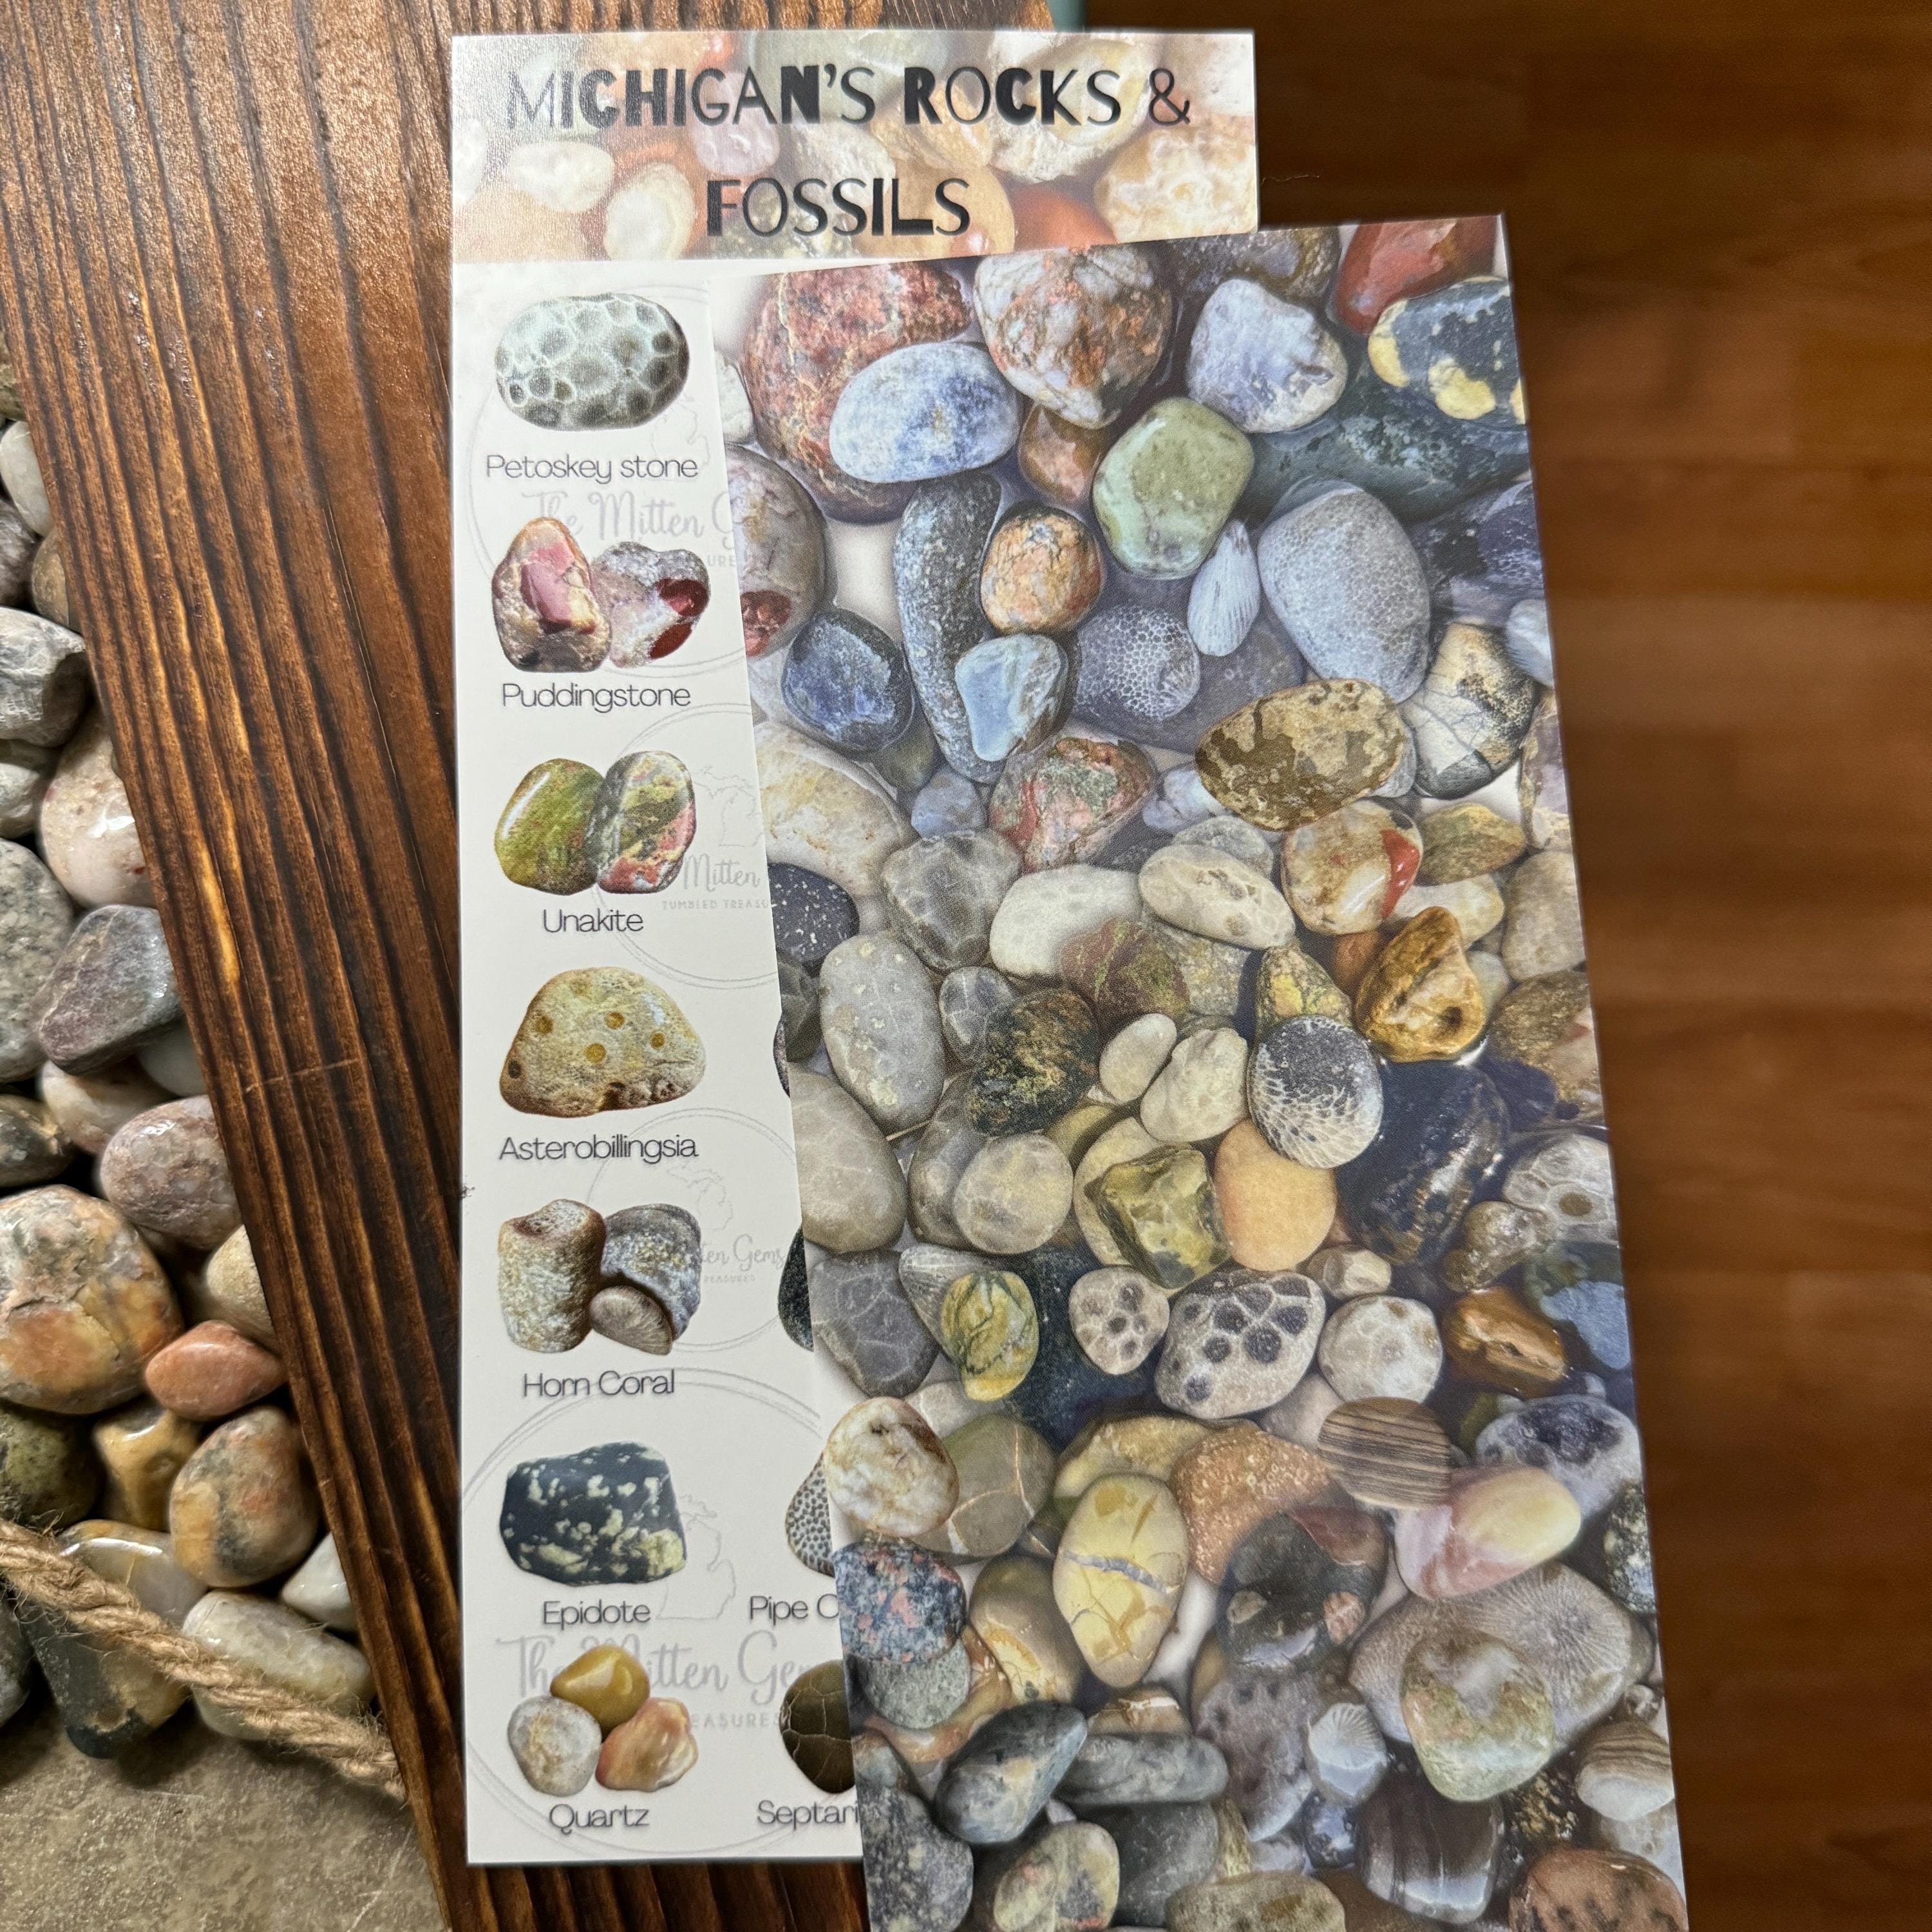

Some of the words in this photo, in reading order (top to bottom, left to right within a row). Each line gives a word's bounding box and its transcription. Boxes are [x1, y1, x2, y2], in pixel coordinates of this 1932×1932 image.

[506, 66, 875, 129] MICHIGAN'S
[904, 66, 1121, 126] ROCKS
[1149, 66, 1191, 125] &
[706, 176, 970, 238] FOSSILS
[486, 453, 611, 485] Petoskey
[620, 455, 699, 478] stone
[587, 490, 705, 541] Mitten
[502, 683, 691, 713] Puddingstone
[724, 899, 770, 909] TREASU
[542, 908, 644, 933] Unakite
[499, 1134, 699, 1164] Asterobillingsia
[524, 1372, 591, 1397] Horn
[599, 1369, 675, 1396] Coral
[543, 1600, 651, 1631] Epidote
[750, 1595, 809, 1627] Pipe
[817, 1593, 839, 1619] C
[495, 1634, 564, 1698] Th
[549, 1803, 650, 1835] Quartz
[757, 1799, 859, 1831] Septari
